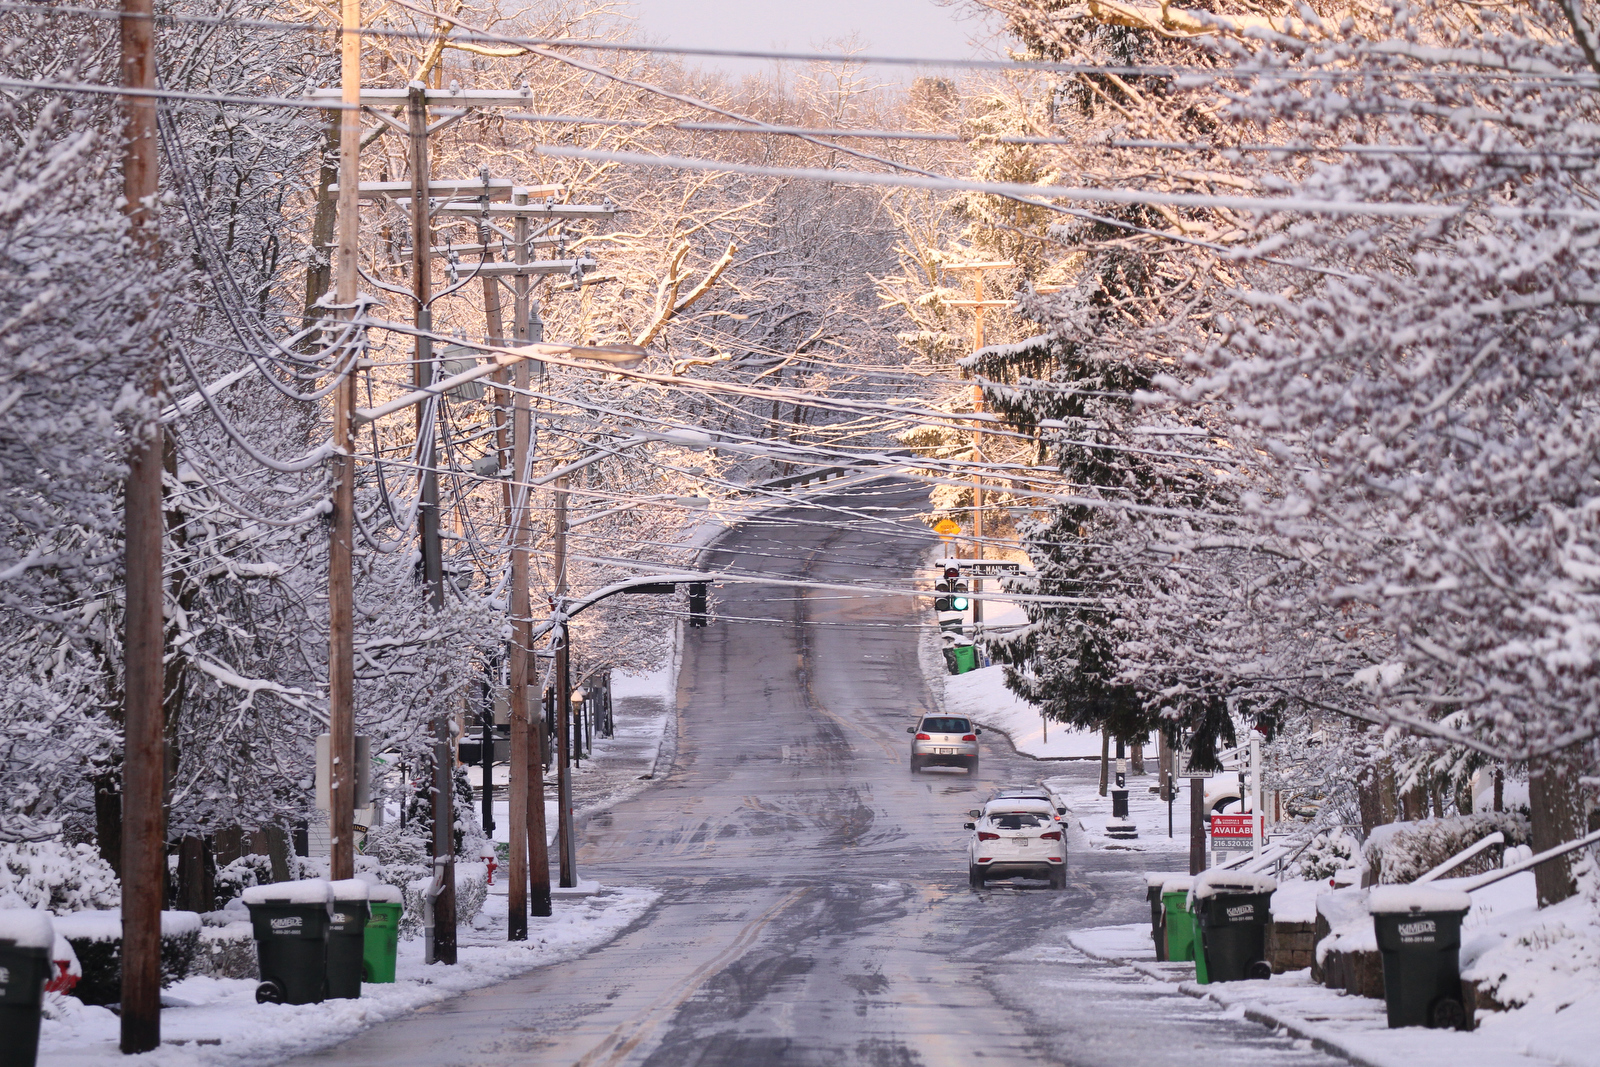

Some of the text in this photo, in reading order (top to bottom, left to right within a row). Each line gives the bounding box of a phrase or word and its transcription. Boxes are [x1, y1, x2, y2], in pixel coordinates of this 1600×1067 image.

[1008, 565, 1017, 575] ST
[1226, 904, 1254, 917] KIMBLE
[270, 916, 303, 929] KIMBLE
[1398, 920, 1437, 936] KIMBLE
